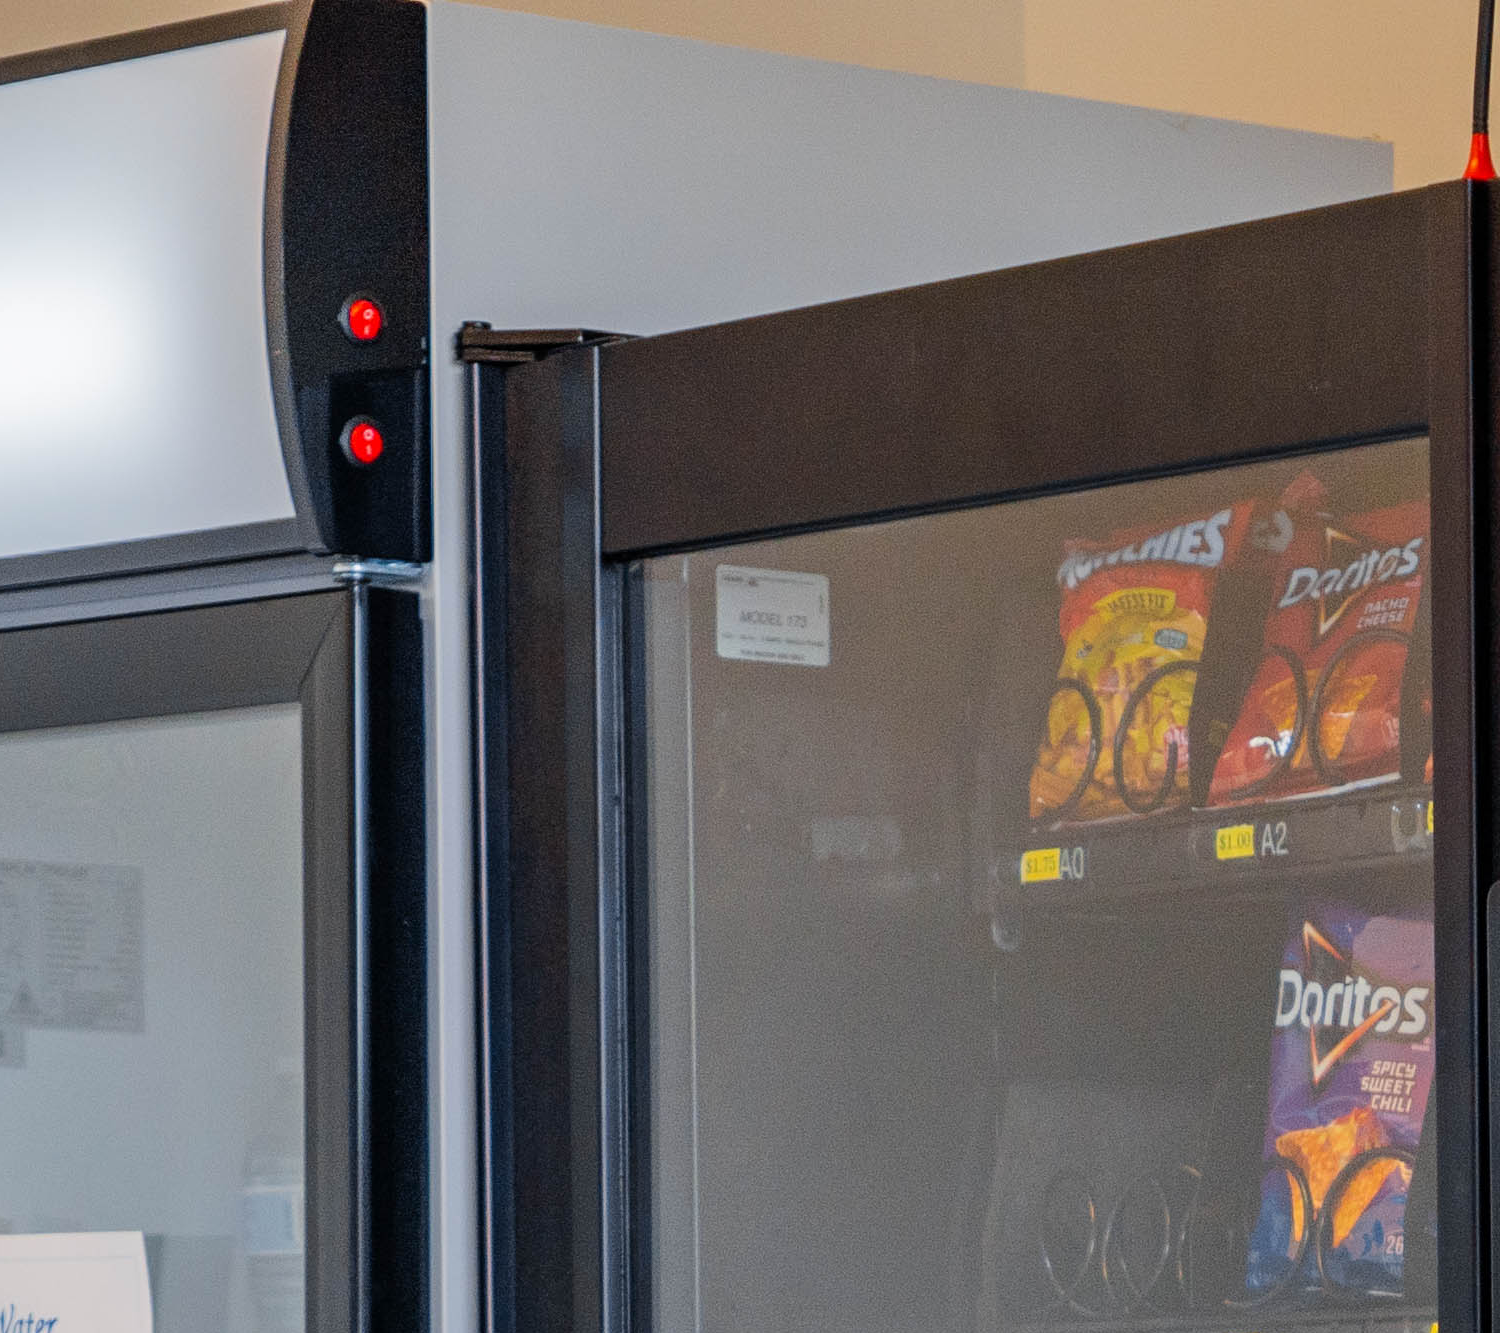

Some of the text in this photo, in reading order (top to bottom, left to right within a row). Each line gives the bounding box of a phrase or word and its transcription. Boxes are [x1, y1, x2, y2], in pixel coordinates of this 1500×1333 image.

[1278, 537, 1424, 609] Doritos
[1364, 597, 1409, 614] NACHO
[1356, 610, 1405, 628] CHEESE
[1261, 823, 1288, 857] A2
[1059, 847, 1084, 879] A0
[1275, 969, 1431, 1034] Doritos
[1371, 1060, 1417, 1079] SPICY
[1360, 1077, 1416, 1096] SWEET
[1370, 1094, 1412, 1113] CHILI
